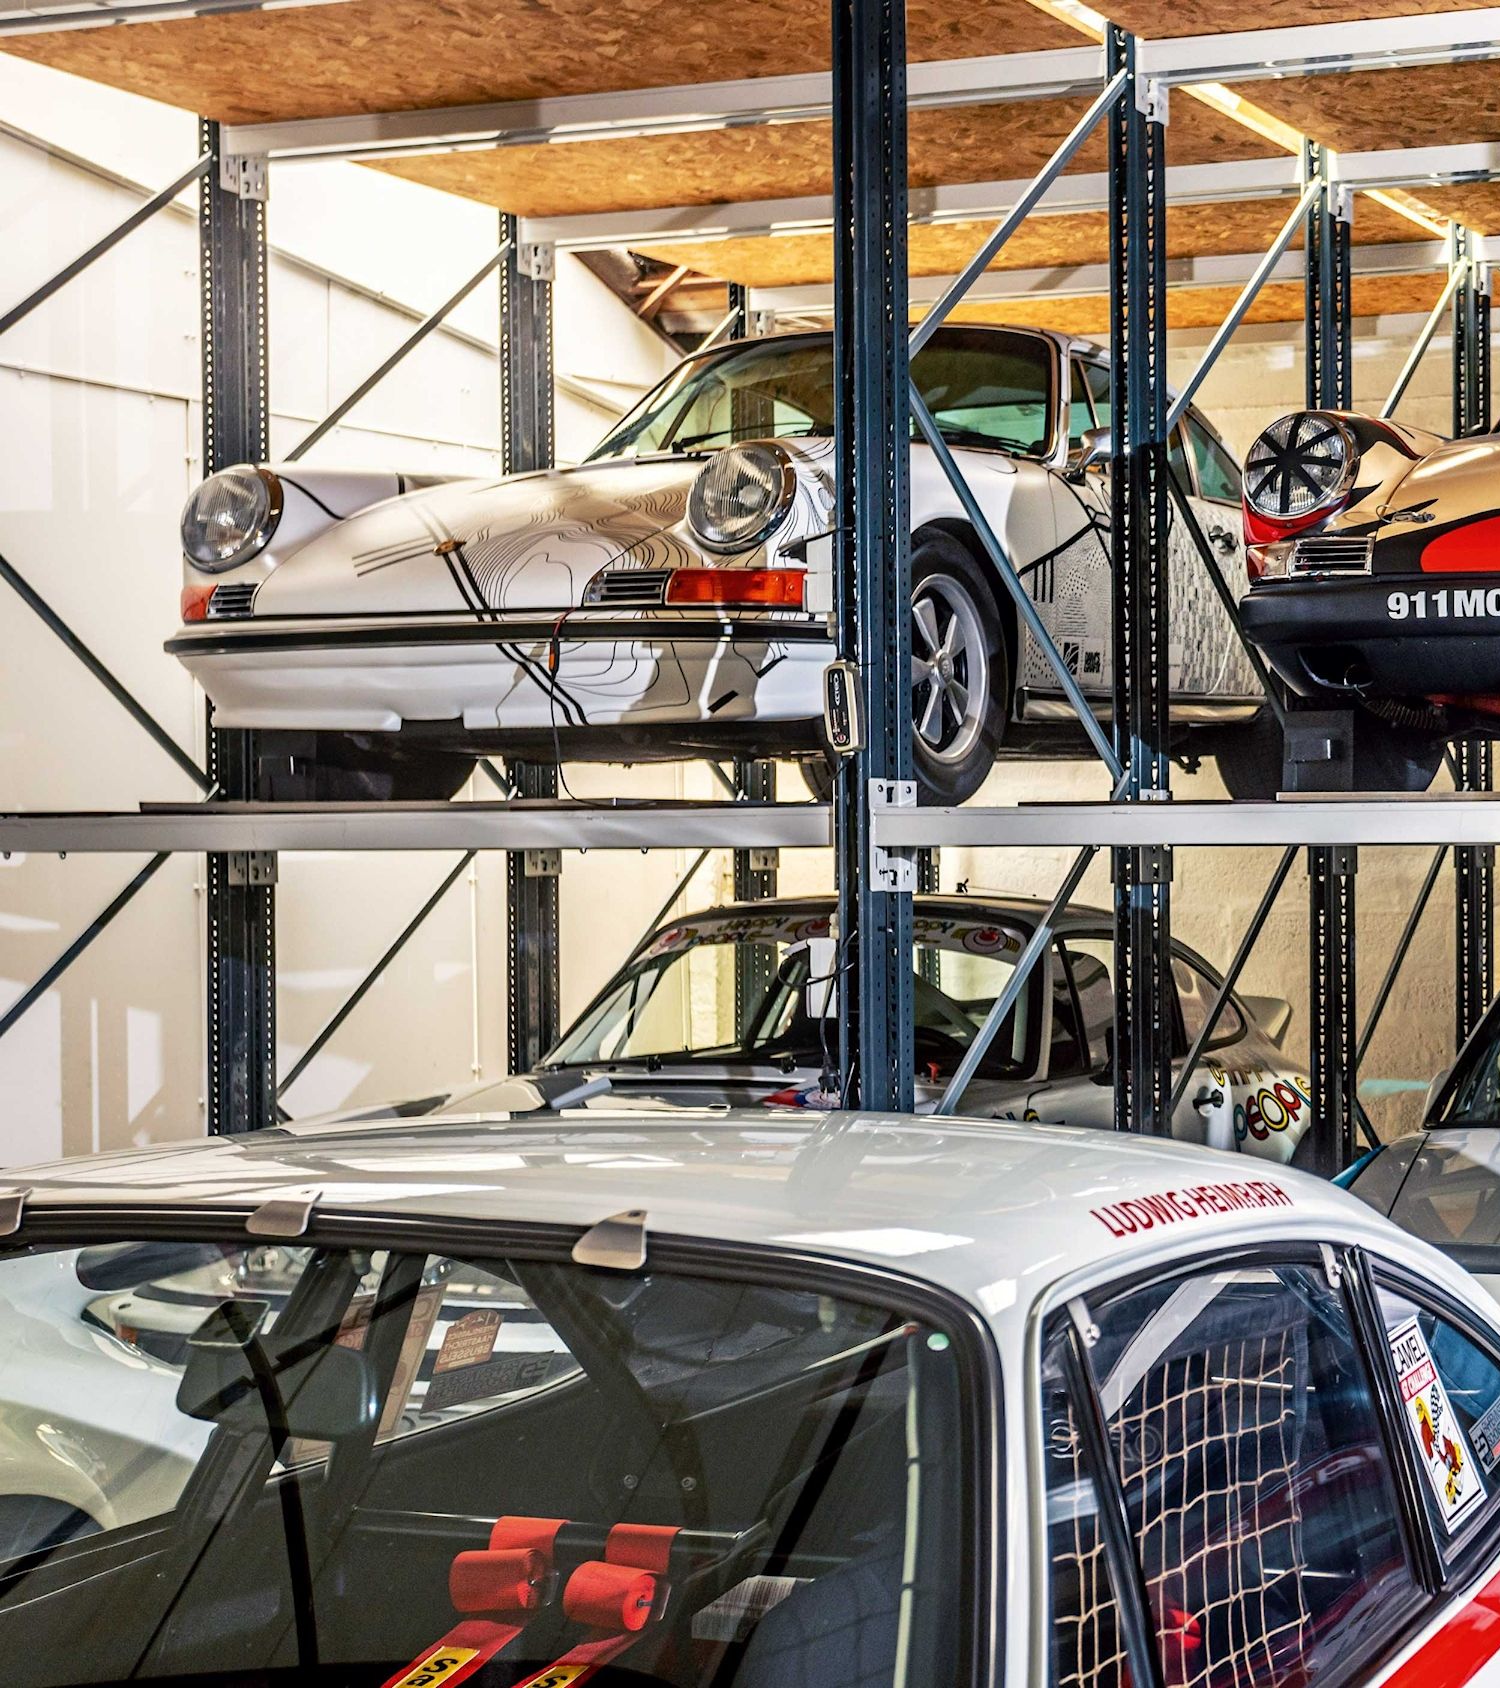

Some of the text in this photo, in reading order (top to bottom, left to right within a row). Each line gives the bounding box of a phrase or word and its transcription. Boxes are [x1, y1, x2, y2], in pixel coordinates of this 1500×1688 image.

[1089, 1181, 1294, 1238] LUDWIG HEIMRATH
[1392, 1334, 1426, 1375] CAMEL
